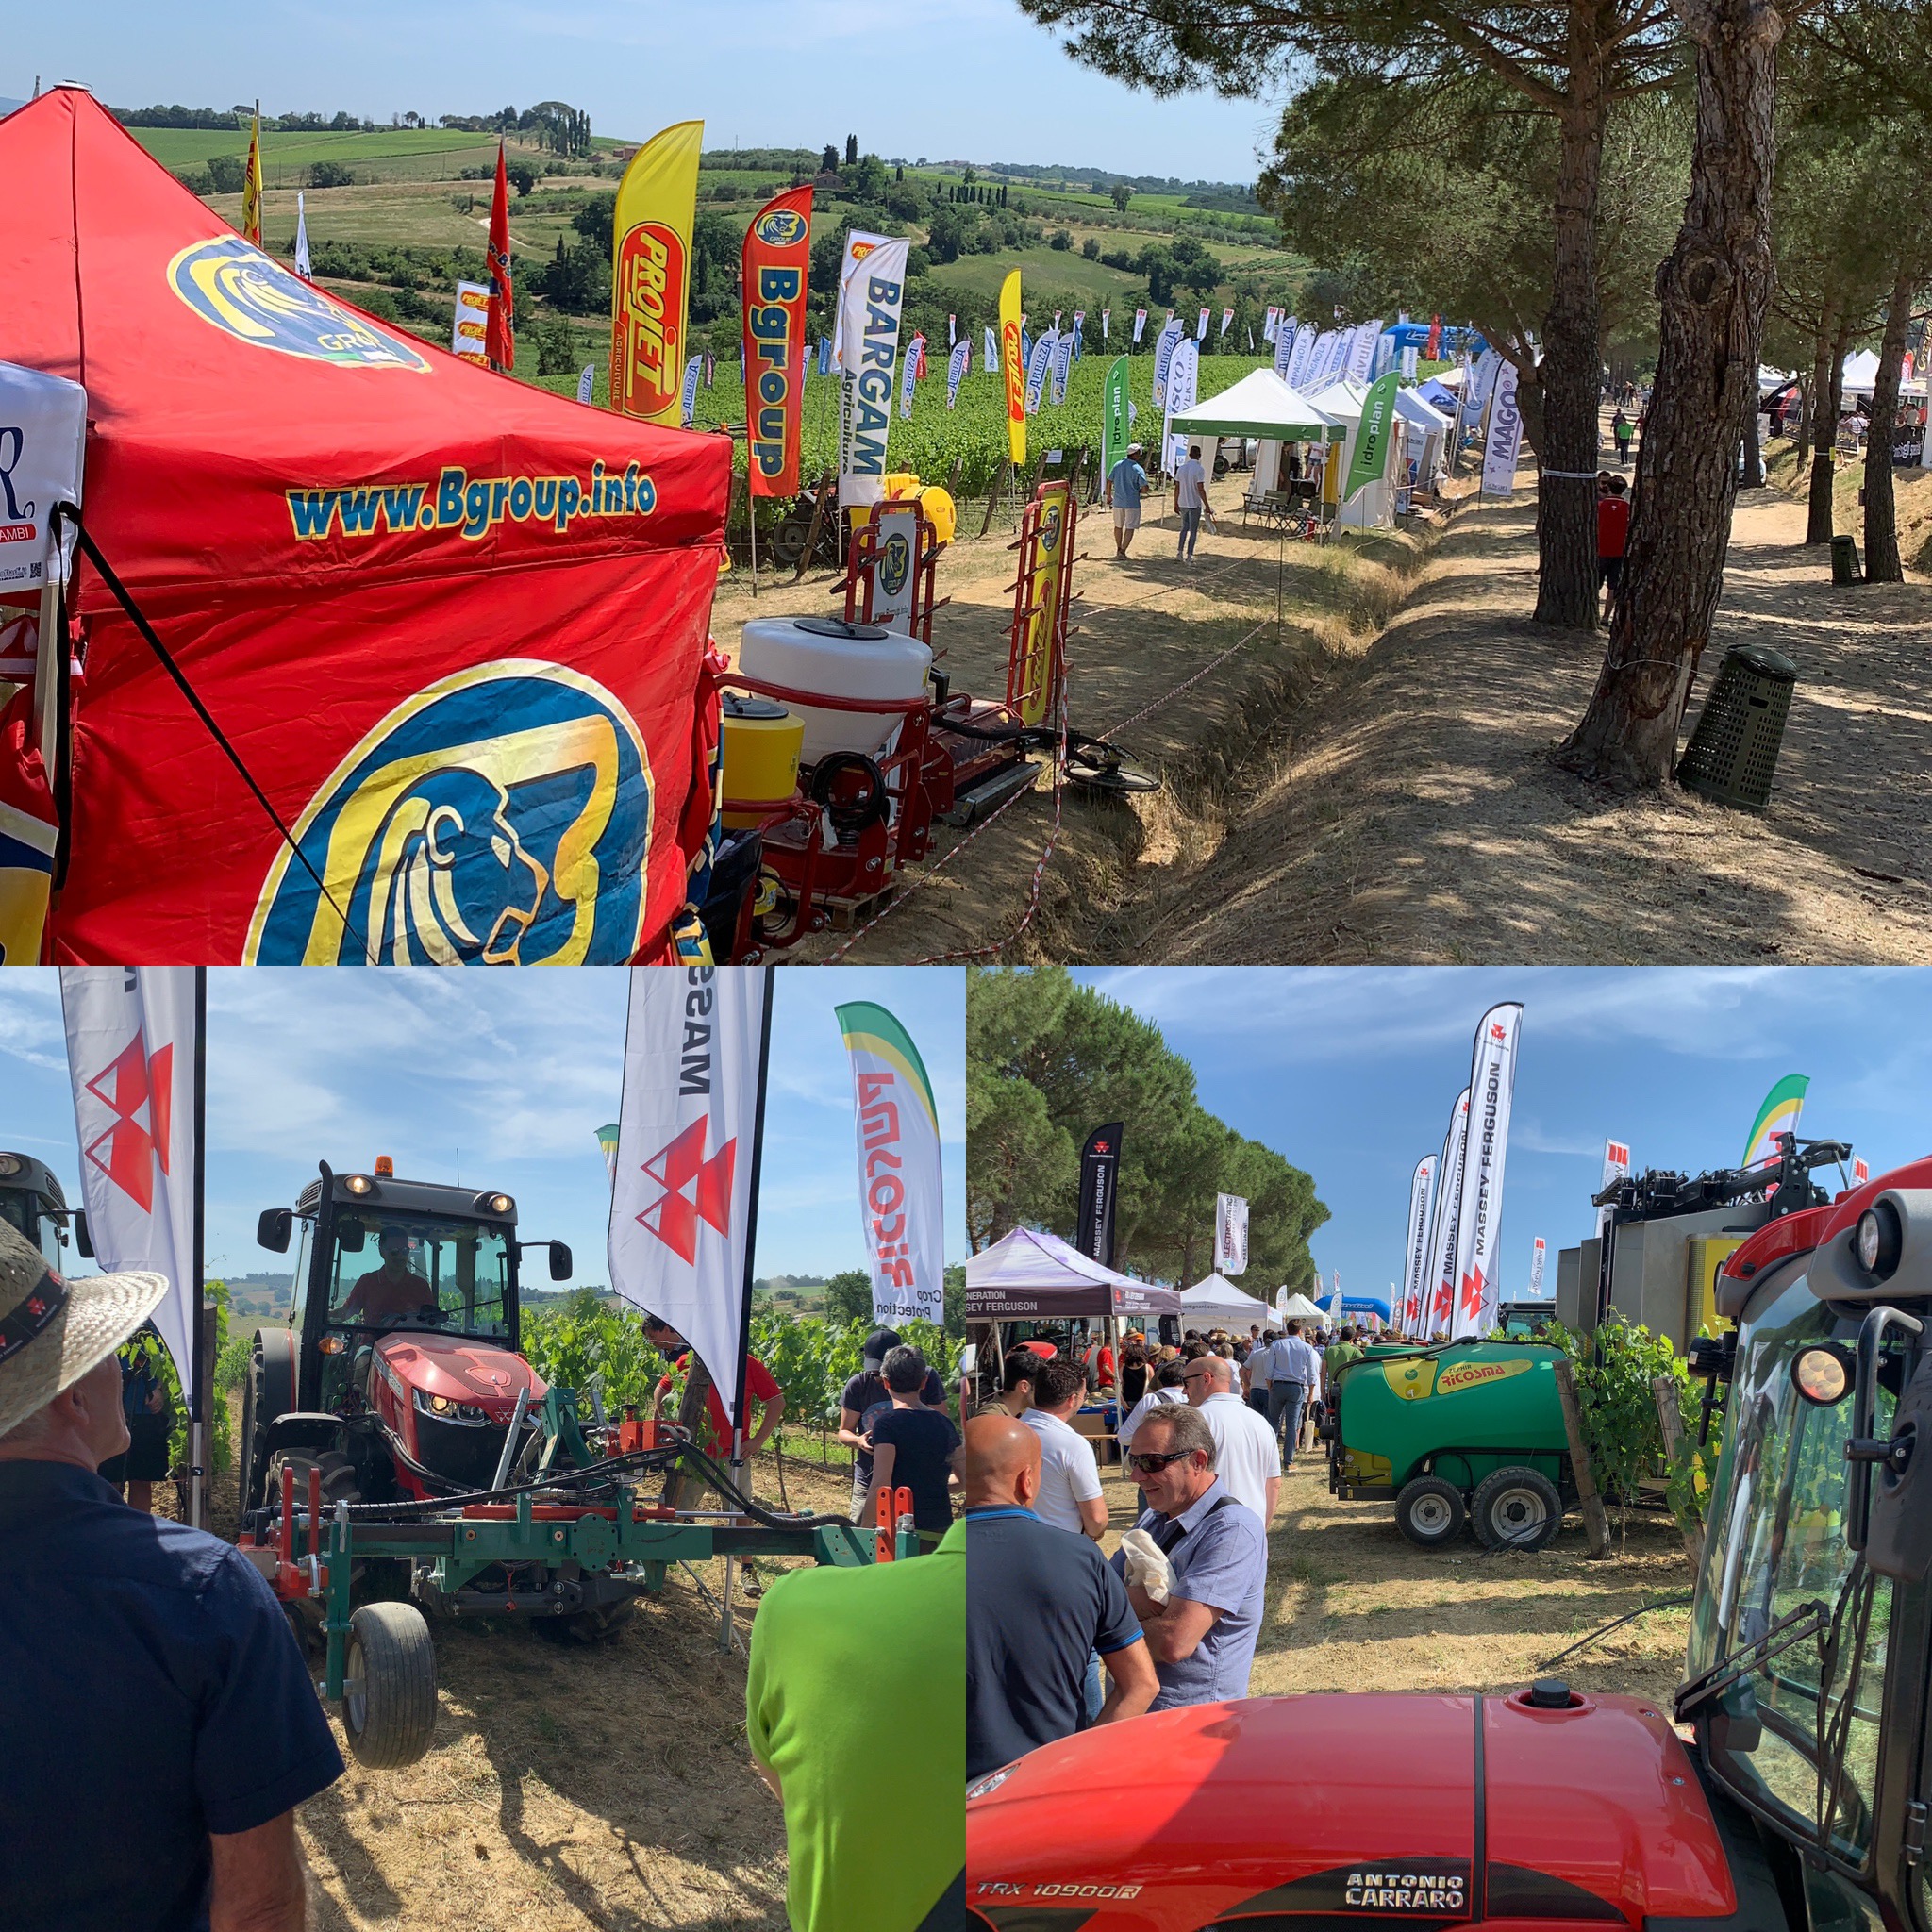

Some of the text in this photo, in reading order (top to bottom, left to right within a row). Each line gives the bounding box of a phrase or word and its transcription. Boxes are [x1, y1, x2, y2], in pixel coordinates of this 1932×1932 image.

[628, 231, 670, 396] PROJET
[613, 333, 624, 401] AGRICULTURE
[749, 266, 802, 478] Bgroup
[852, 275, 902, 475] BARGAM
[1029, 339, 1055, 391] ARRIZZA
[1056, 341, 1072, 385] ARRIZZA
[841, 368, 858, 475] Agriculture
[1360, 400, 1385, 466] idroplan
[1492, 391, 1518, 461] MAGO
[285, 458, 658, 541] www.Bgroup.info
[1476, 1061, 1501, 1256] MASSEY FERGUSON
[1093, 1164, 1106, 1257] MASSEY FERGUSON
[1224, 1197, 1233, 1258] ELECTROSTATIC
[1414, 1248, 1423, 1290] MASSEY
[1443, 1215, 1457, 1274] MASSEY
[986, 1302, 1038, 1312] FERGUSON
[976, 1882, 1027, 1896] TRX
[1345, 1888, 1464, 1908] CARRARO
[1347, 1873, 1464, 1889] ANTONIO
